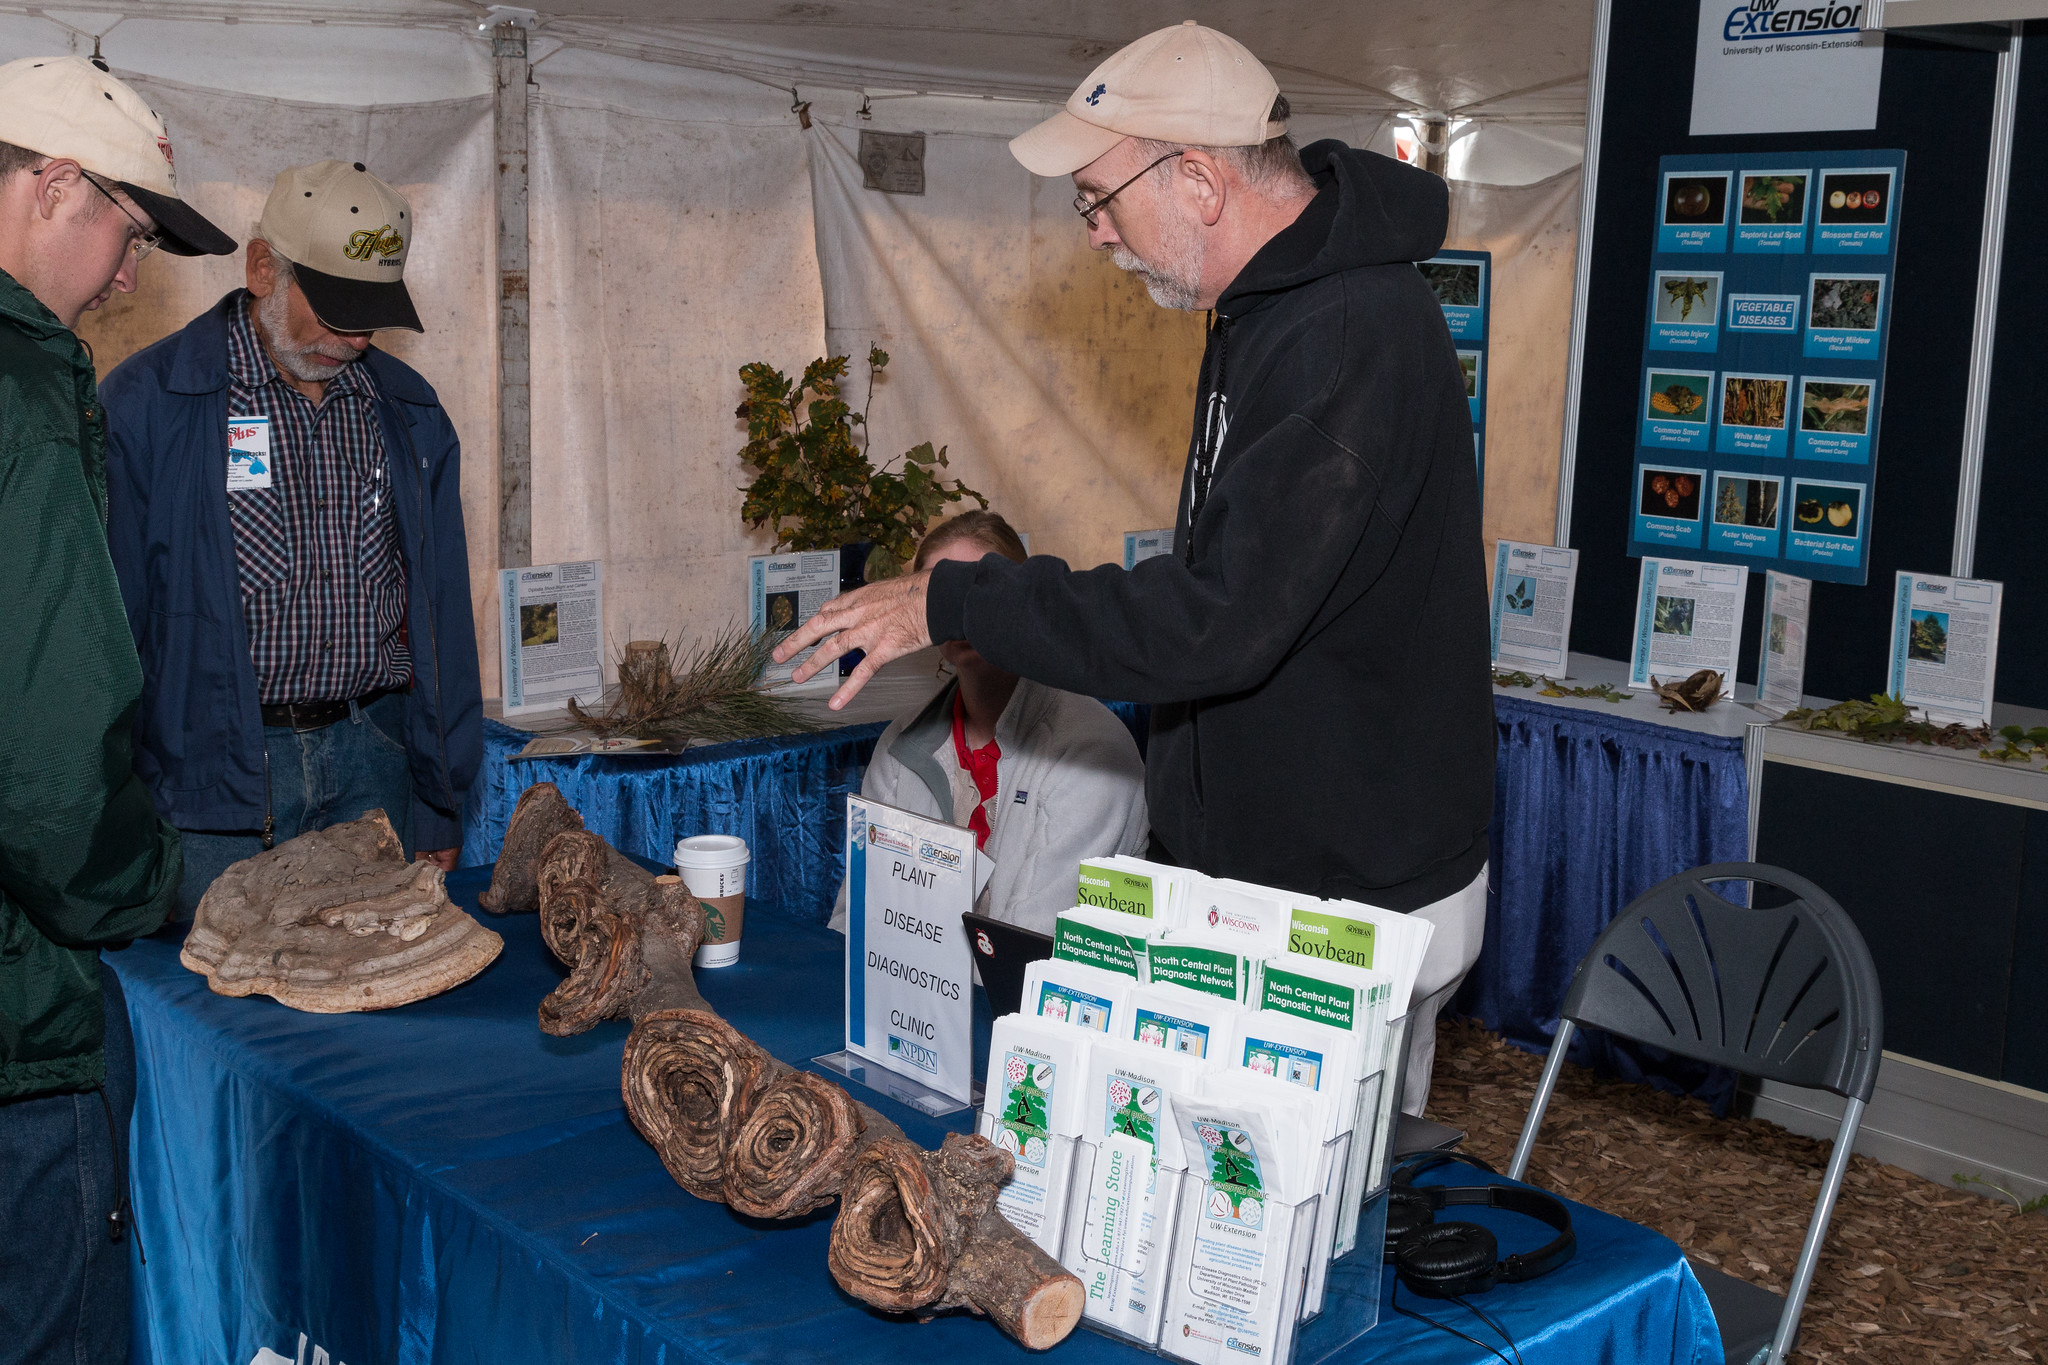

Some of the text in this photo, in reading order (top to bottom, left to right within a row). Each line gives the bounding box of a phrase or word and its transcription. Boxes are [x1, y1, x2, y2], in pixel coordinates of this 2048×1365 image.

[1750, 0, 1779, 12] UW
[1723, 39, 1864, 55] University of Wisconsin-Extension
[1691, 231, 1711, 240] Blight
[1740, 231, 1801, 240] Septoria Leaf Spot
[1822, 231, 1883, 239] Blossom End Rot
[1736, 301, 1793, 313] VEGETABLE
[1451, 319, 1467, 327] Cast
[1738, 315, 1787, 326] DISEASES
[1659, 328, 1710, 340] Herbicide Injury
[1814, 335, 1871, 344] Powdery Mildew
[1653, 425, 1700, 436] Common Smut
[1734, 432, 1771, 442] White Mold
[1808, 437, 1858, 448] Common Rust
[1646, 521, 1691, 533] Common Scab
[1722, 530, 1767, 542] Aster Yellows
[1794, 538, 1855, 551] Bacterial Soft Rot
[1641, 609, 1650, 639] Wisconsin
[510, 658, 516, 666] of
[920, 843, 960, 864] Extension
[892, 860, 937, 889] PLANT
[1079, 874, 1110, 888] Wisconsin
[1077, 887, 1146, 916] Soybean
[884, 908, 944, 944] DISEASE
[1221, 915, 1260, 932] WISCONSIN
[1291, 920, 1329, 935] Wisconsin
[1063, 931, 1133, 958] North Central Plan
[1289, 933, 1365, 967] Soybean
[1062, 942, 1101, 960] Diagnostic
[1103, 954, 1136, 970] Network
[1153, 956, 1233, 975] North Central Plant
[867, 951, 960, 1001] DIAGNOSTICS
[1153, 966, 1234, 989] Diagnostic Network
[1058, 986, 1098, 1002] UW-EXTENSION
[1269, 981, 1350, 1010] North Central Plant
[1267, 993, 1350, 1023] Diagnostic Network
[890, 1009, 935, 1041] CLINIC
[1153, 1013, 1194, 1028] UW-EXTENSION
[900, 1040, 936, 1068] NPDN
[1013, 1045, 1051, 1060] UW-Madison
[1263, 1042, 1308, 1057] UW-EXTENSION
[1115, 1068, 1156, 1085] UW-Madison
[1006, 1082, 1049, 1100] PLANT DISEASE
[1110, 1105, 1156, 1123] PLANT DISEASE
[1196, 1116, 1240, 1128] UW-Madison
[995, 1117, 1053, 1140] DIAGNOSTICS CLINIC
[1206, 1144, 1254, 1160] PLANT DISEASE
[1204, 1179, 1269, 1200] DIAGNOSTICS CLINIC
[1089, 1150, 1122, 1300] The Learning Store
[1209, 1222, 1257, 1239] UW-Extension
[1202, 1265, 1217, 1273] Disease
[1217, 1270, 1241, 1279] Diagnostics
[1197, 1276, 1217, 1285] University
[1200, 1271, 1222, 1280] Department
[1238, 1281, 1258, 1290] Pathology
[1226, 1337, 1262, 1354] Extension
